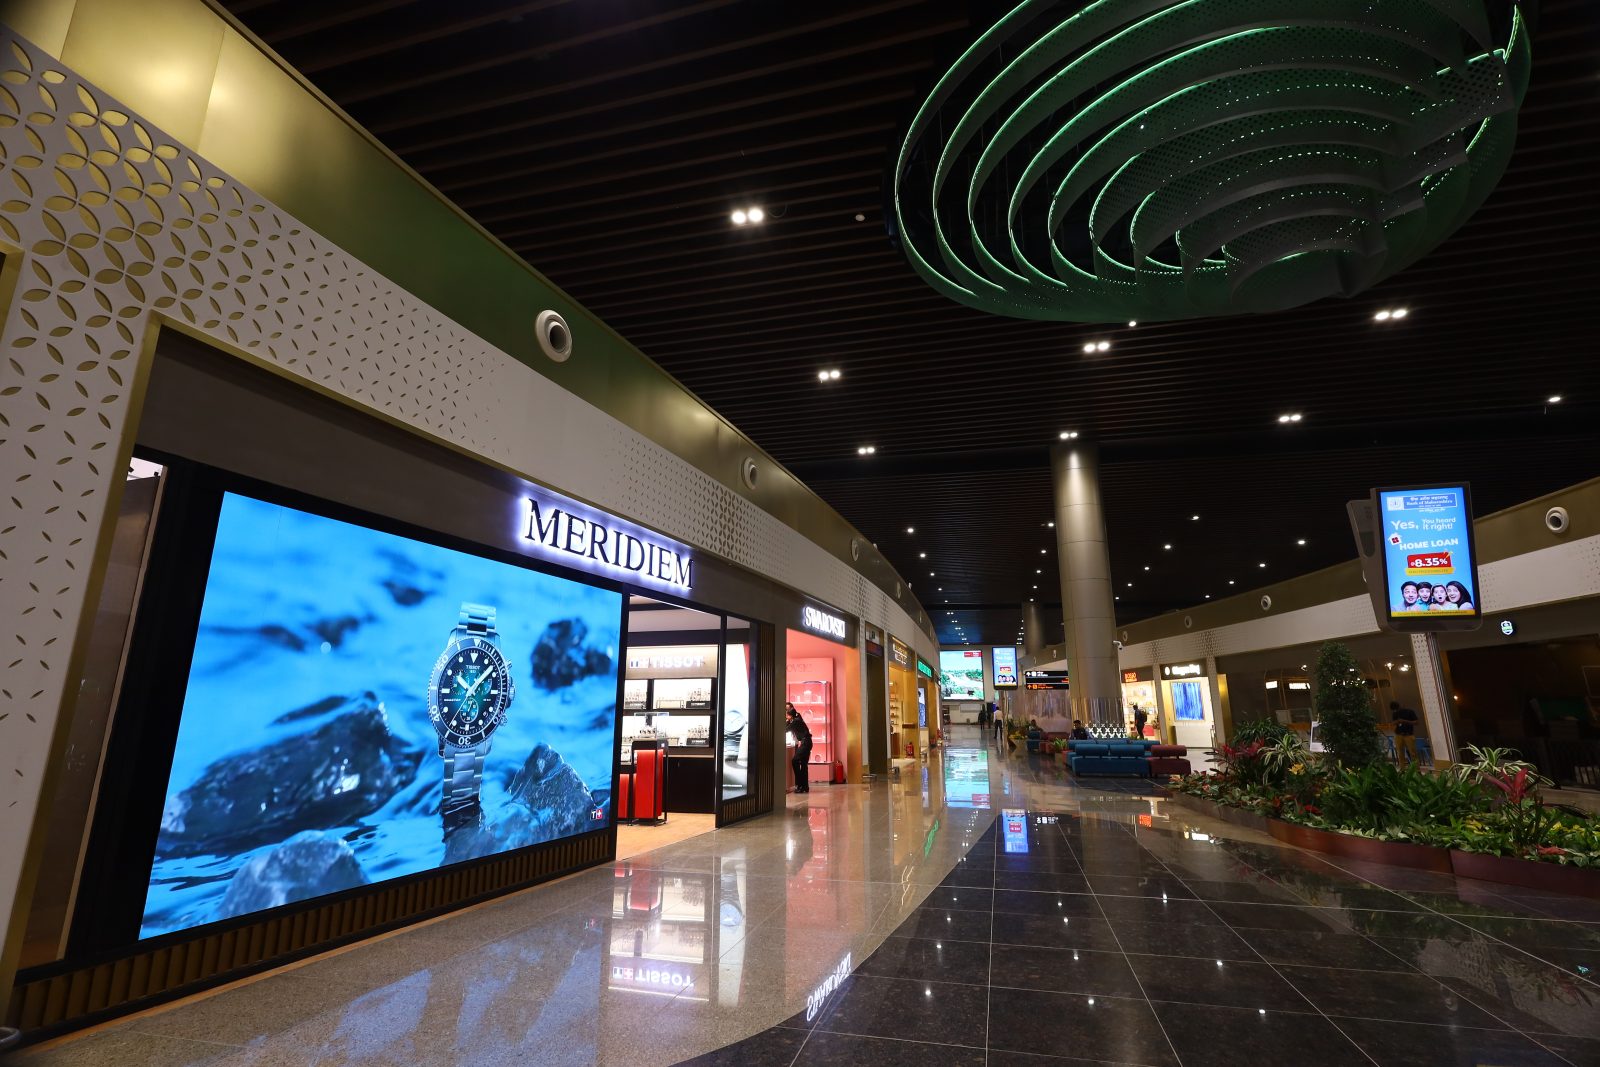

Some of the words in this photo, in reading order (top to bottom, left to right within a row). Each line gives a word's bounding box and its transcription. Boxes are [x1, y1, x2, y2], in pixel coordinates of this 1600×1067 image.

[1391, 520, 1419, 530] Yes,
[1430, 523, 1453, 531] right!
[525, 498, 694, 589] MERIDIEM
[1400, 542, 1429, 551] HOME
[1431, 538, 1459, 548] LOAN
[652, 656, 704, 668] TISSOT
